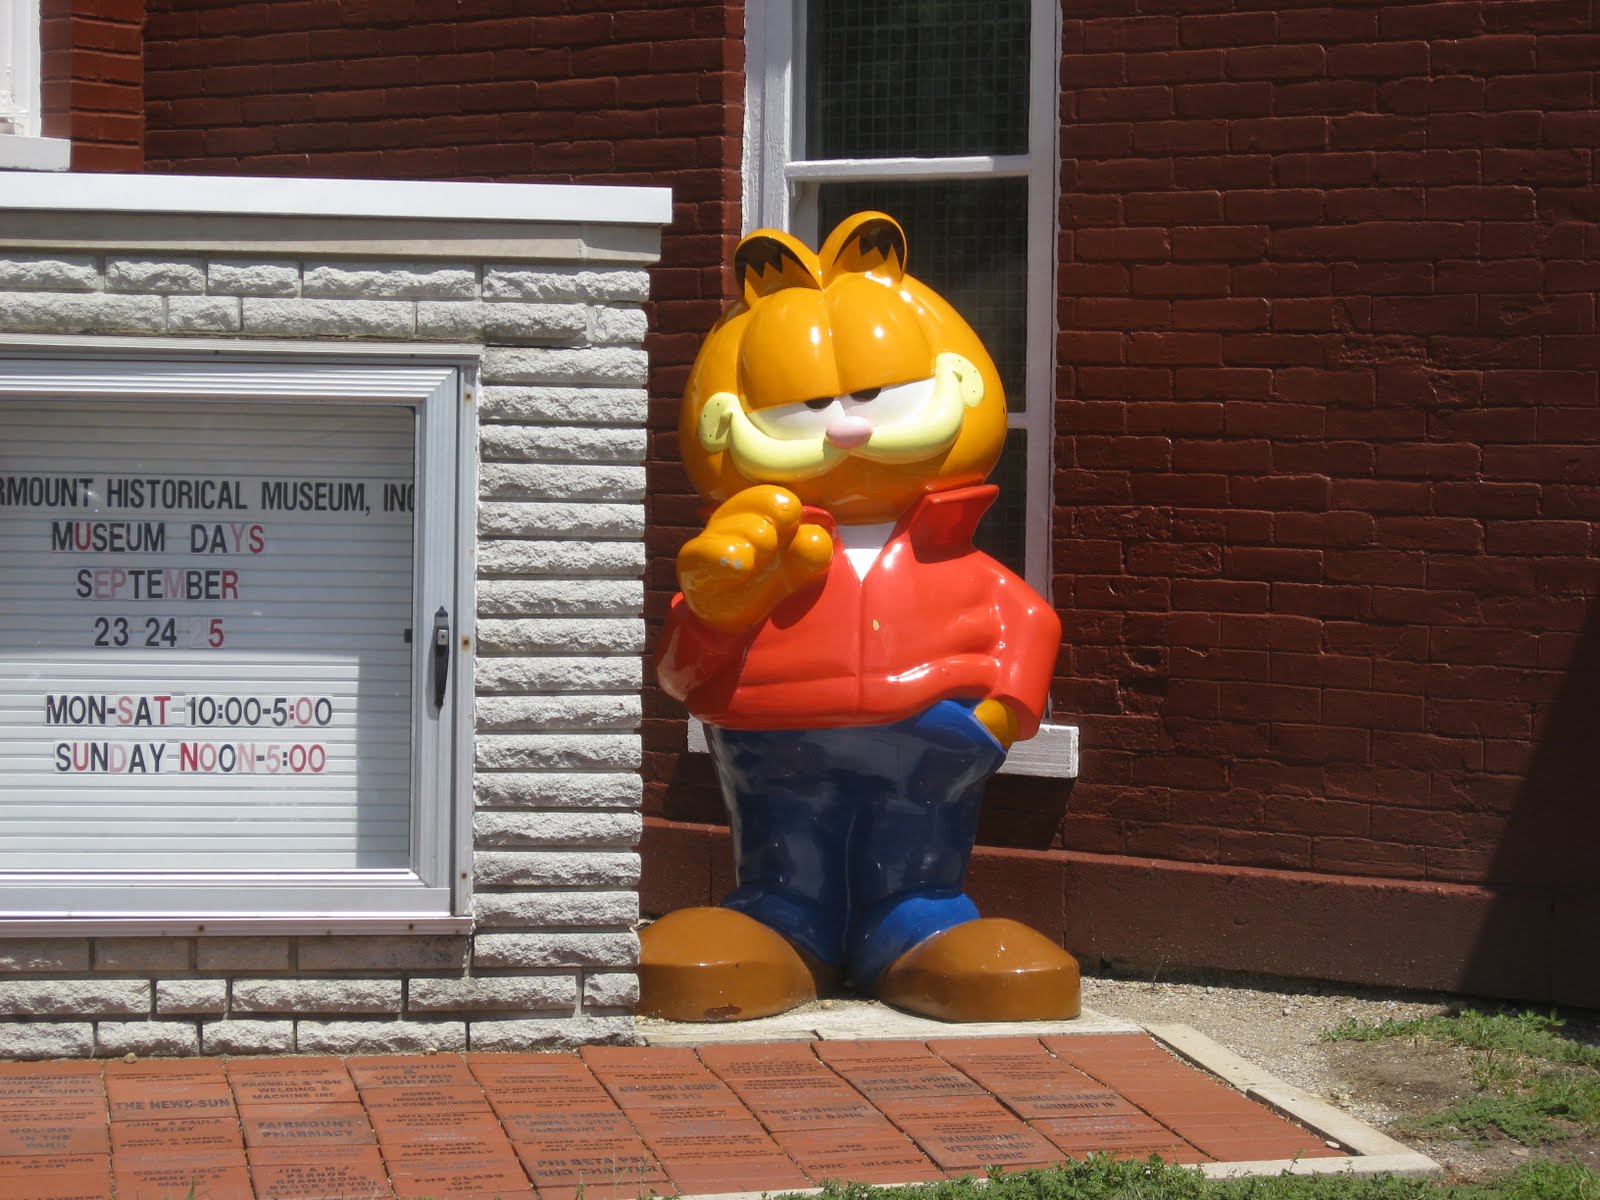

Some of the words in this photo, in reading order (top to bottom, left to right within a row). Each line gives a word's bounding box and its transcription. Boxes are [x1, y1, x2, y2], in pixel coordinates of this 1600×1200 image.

[106, 479, 248, 510] HISTORICAL
[260, 481, 371, 516] MUSEUM,
[51, 522, 165, 553] MUSEUM
[190, 524, 265, 554] DAYS
[76, 569, 239, 600] SEPTEMBER
[94, 616, 129, 647] 23
[145, 617, 177, 648] 24
[45, 695, 172, 725] MON-SAT
[187, 696, 333, 727] 10:00-5:00
[55, 742, 166, 773] SUNDAY
[179, 742, 326, 773] NOON-5:00
[114, 1101, 145, 1111] THE
[149, 1098, 230, 1110] NEWS-SUN
[252, 1092, 311, 1100] MACHINE
[256, 1119, 354, 1129] FAIRMOUNT
[260, 1129, 353, 1139] PHARMACY
[860, 1158, 924, 1168] MICKEY
[275, 1175, 368, 1185] GRANDSONS
